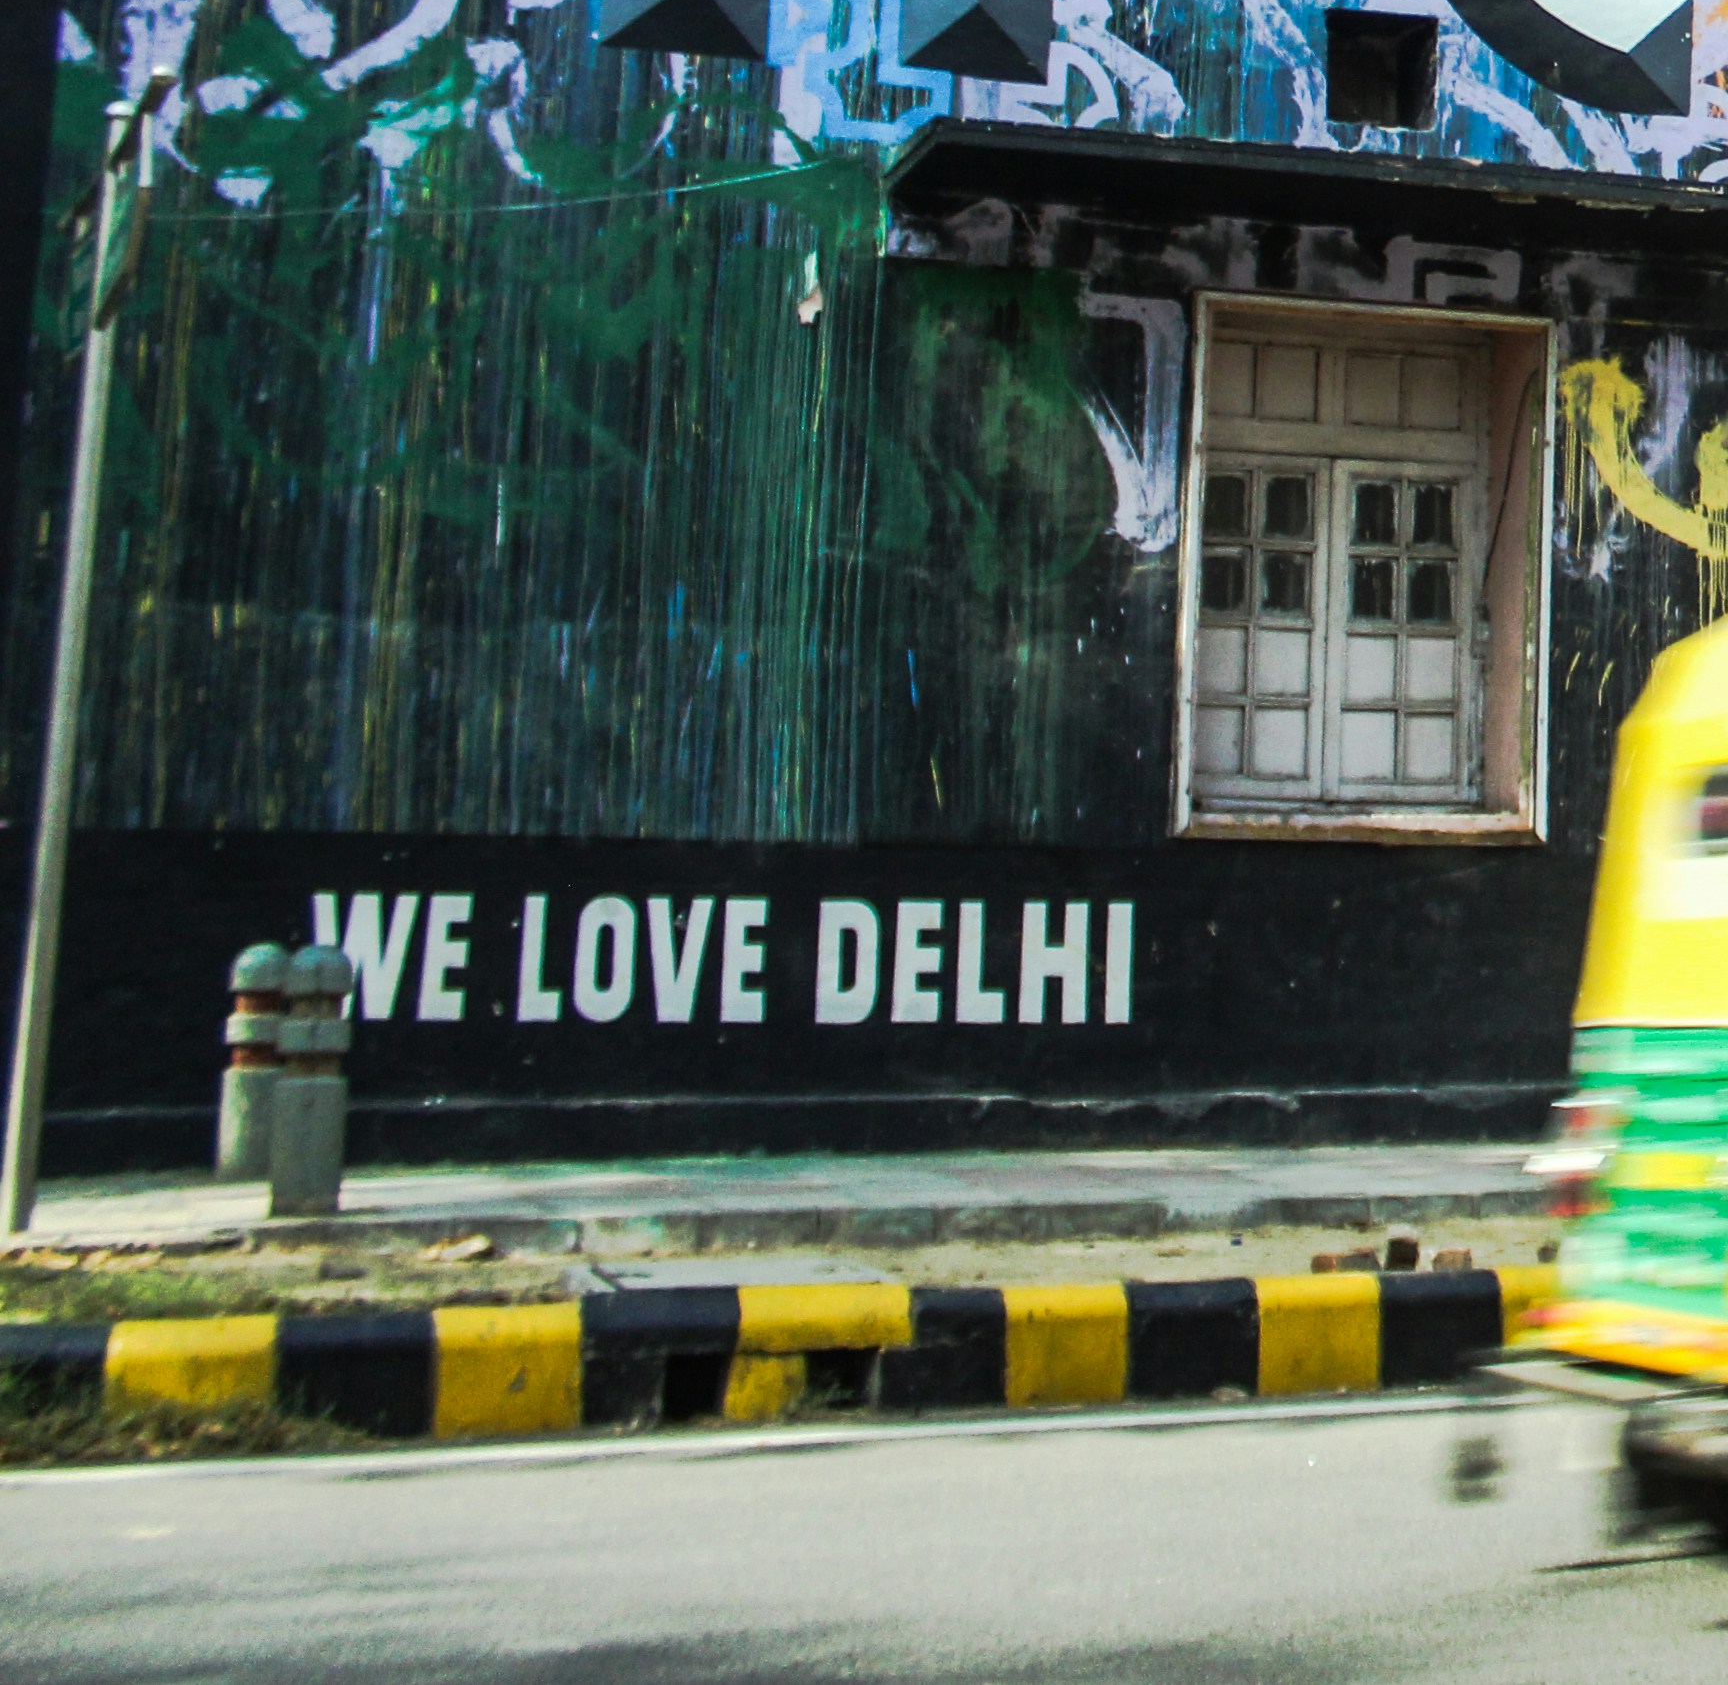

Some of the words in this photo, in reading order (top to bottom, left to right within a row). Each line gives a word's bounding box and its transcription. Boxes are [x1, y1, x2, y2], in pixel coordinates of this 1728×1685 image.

[312, 892, 474, 1022] WE
[516, 895, 769, 1023] LOVE
[814, 898, 1133, 1024] DELHI
